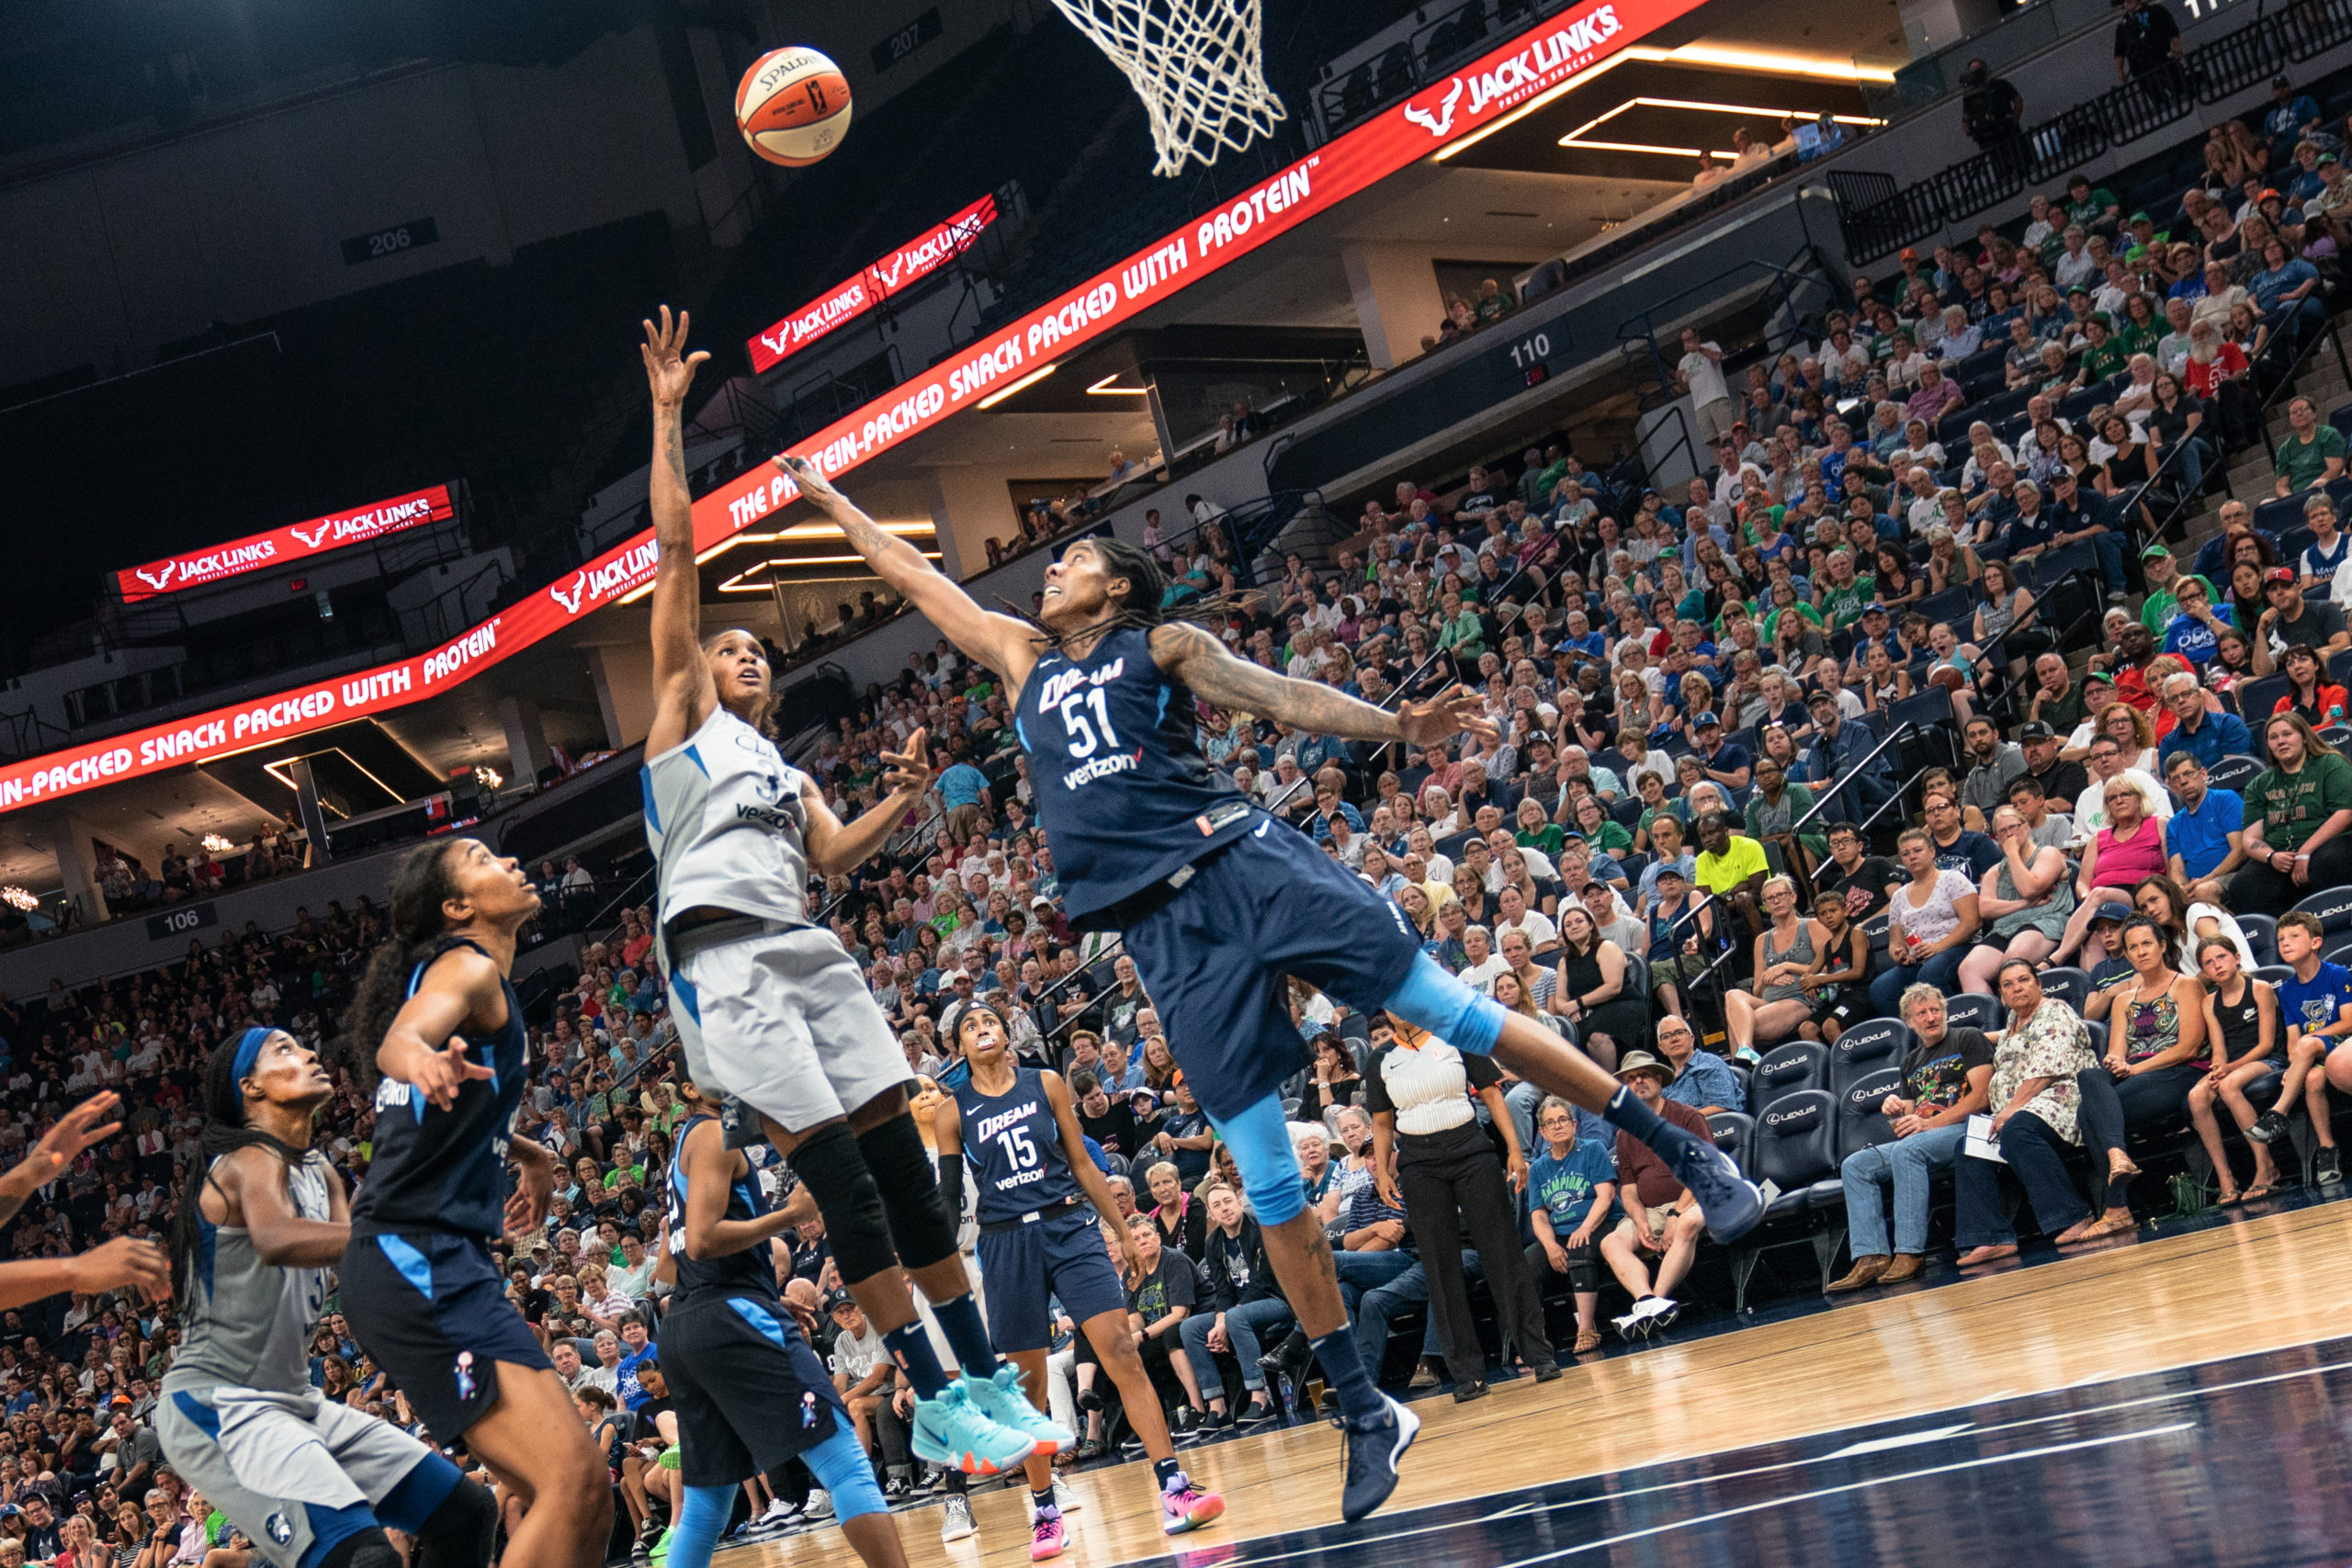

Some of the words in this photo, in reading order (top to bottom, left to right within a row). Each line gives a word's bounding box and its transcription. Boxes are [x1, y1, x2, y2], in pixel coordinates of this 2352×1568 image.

[890, 24, 920, 59] 207
[1468, 50, 1539, 115] JACK
[1532, 5, 1620, 74] LINK'S
[1498, 79, 1547, 109] PROTEIN
[1550, 52, 1594, 82] SNACKS
[368, 228, 411, 256] 206
[906, 242, 943, 274] JACK
[792, 311, 827, 343] JACK
[822, 285, 865, 321] LINK'S
[808, 324, 831, 341] PROTEIN
[831, 310, 853, 327] SNACKS
[1510, 333, 1550, 367] 110
[729, 486, 767, 530] THE
[770, 383, 944, 501] PRTEIN-PACKED
[948, 336, 1023, 402] SNACK
[1027, 281, 1117, 356] PACKED
[1122, 237, 1189, 299] WITH
[332, 512, 377, 541] JACK
[375, 497, 433, 527] LINK'S
[177, 552, 220, 581] JACK
[220, 539, 277, 568] LINK'S
[198, 570, 229, 582] PROTEIN
[231, 561, 259, 574] SNACKS
[588, 558, 630, 600] JACK
[606, 580, 637, 599] PROTEIN
[141, 719, 226, 766] SNACK
[233, 690, 334, 739] PACKED
[342, 667, 411, 707] WITH
[1059, 687, 1121, 759] 51
[1063, 753, 1137, 791] verizon
[2215, 763, 2252, 781] LEXUS
[164, 910, 198, 931] 106
[1854, 1030, 1892, 1046] LEXUS
[1774, 1055, 1808, 1071] LEXUS
[978, 1101, 1037, 1145] DREAM
[1780, 1105, 1817, 1122] LEXUS
[996, 1125, 1038, 1172] 15
[995, 1168, 1045, 1191] verizon
